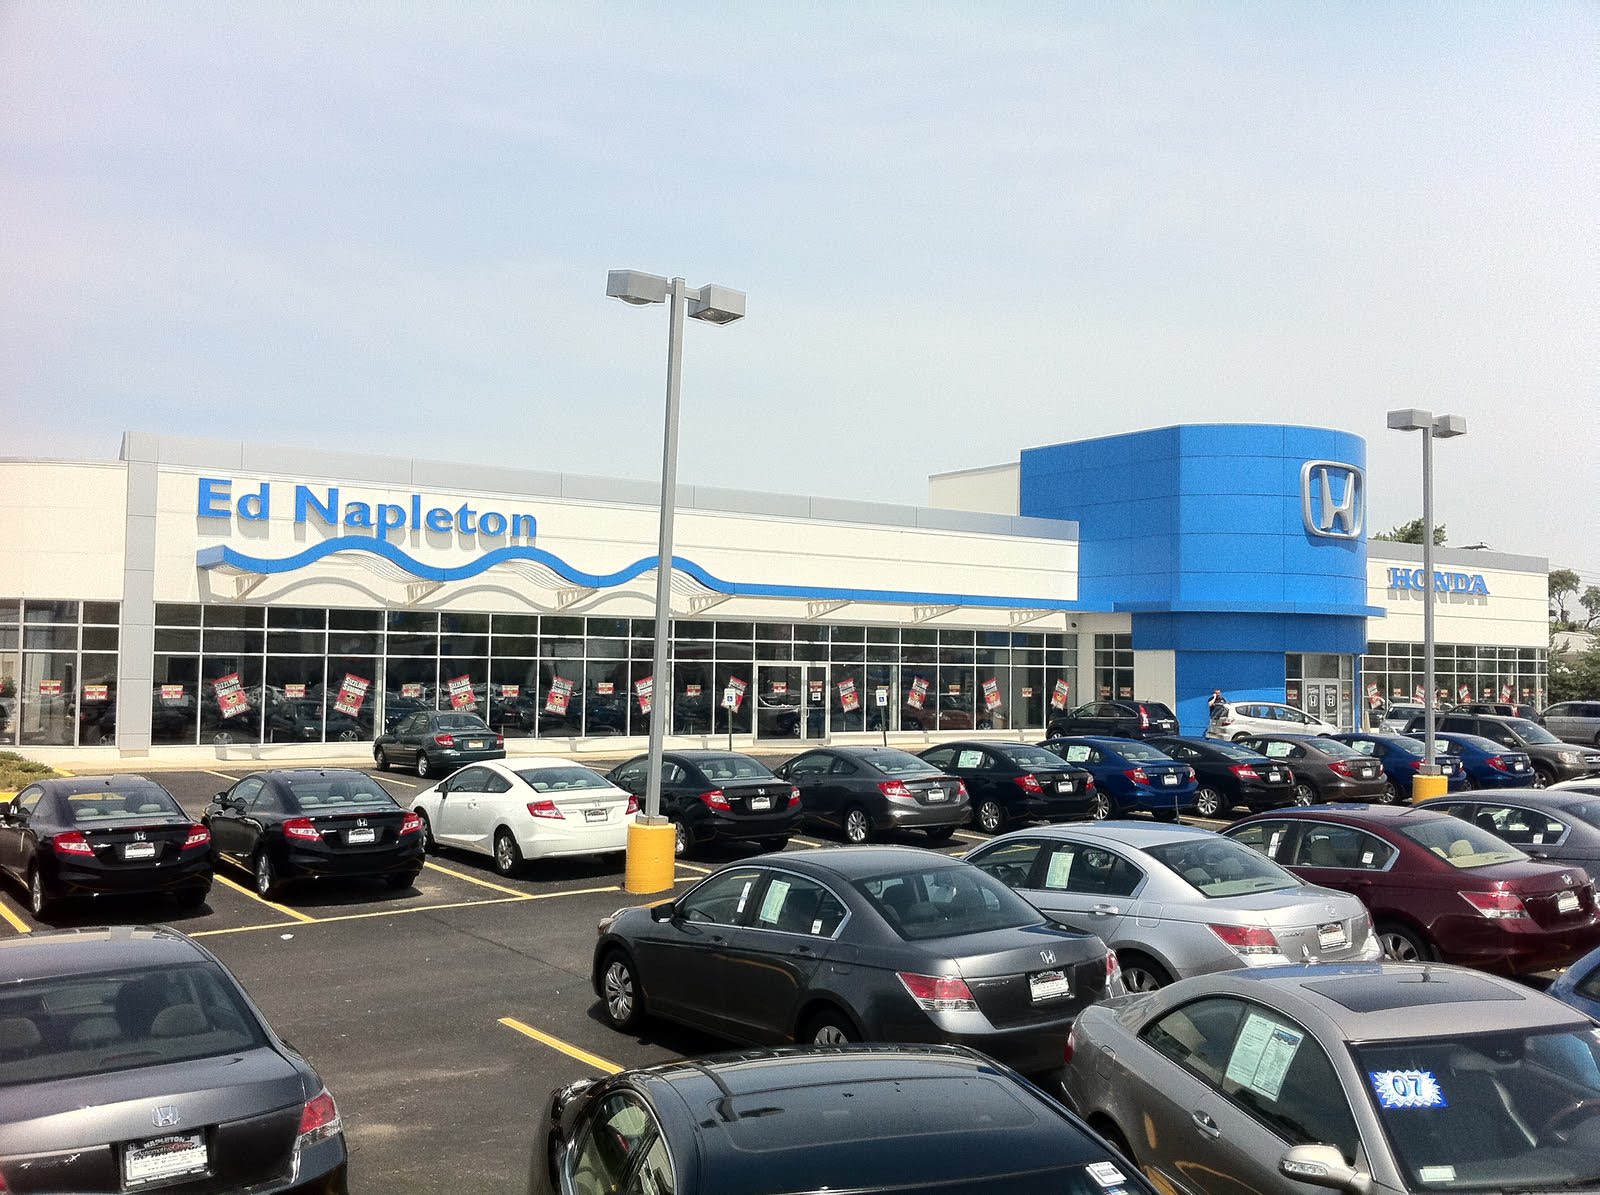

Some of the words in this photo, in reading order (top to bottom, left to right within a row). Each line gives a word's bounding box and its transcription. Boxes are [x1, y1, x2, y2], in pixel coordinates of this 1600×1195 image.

[198, 477, 270, 520] Ed
[295, 484, 537, 541] Napleton
[1390, 567, 1490, 595] HONDA
[1392, 1075, 1423, 1097] 07
